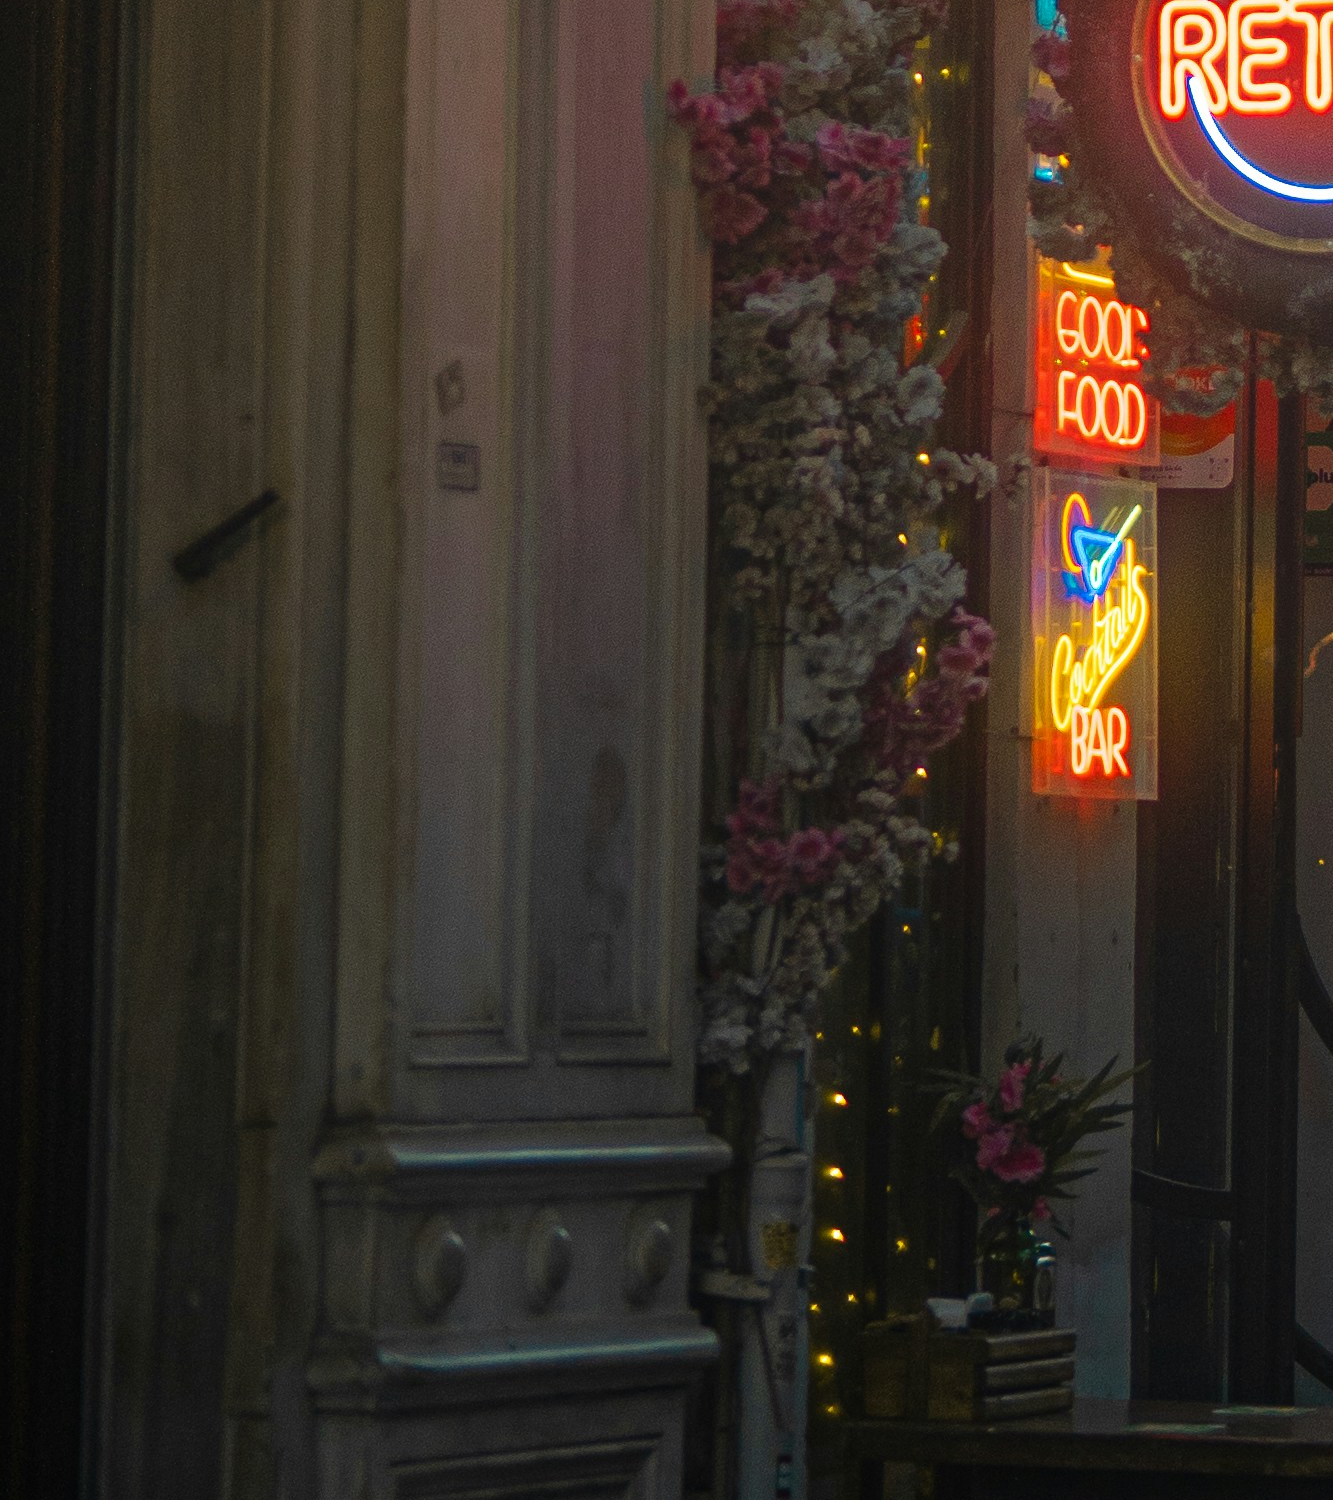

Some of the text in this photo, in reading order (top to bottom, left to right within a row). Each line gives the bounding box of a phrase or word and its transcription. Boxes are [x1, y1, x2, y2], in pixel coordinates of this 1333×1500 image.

[1056, 291, 1149, 367] GOOD
[1058, 370, 1147, 446] FOOD
[1071, 705, 1130, 777] BAR
